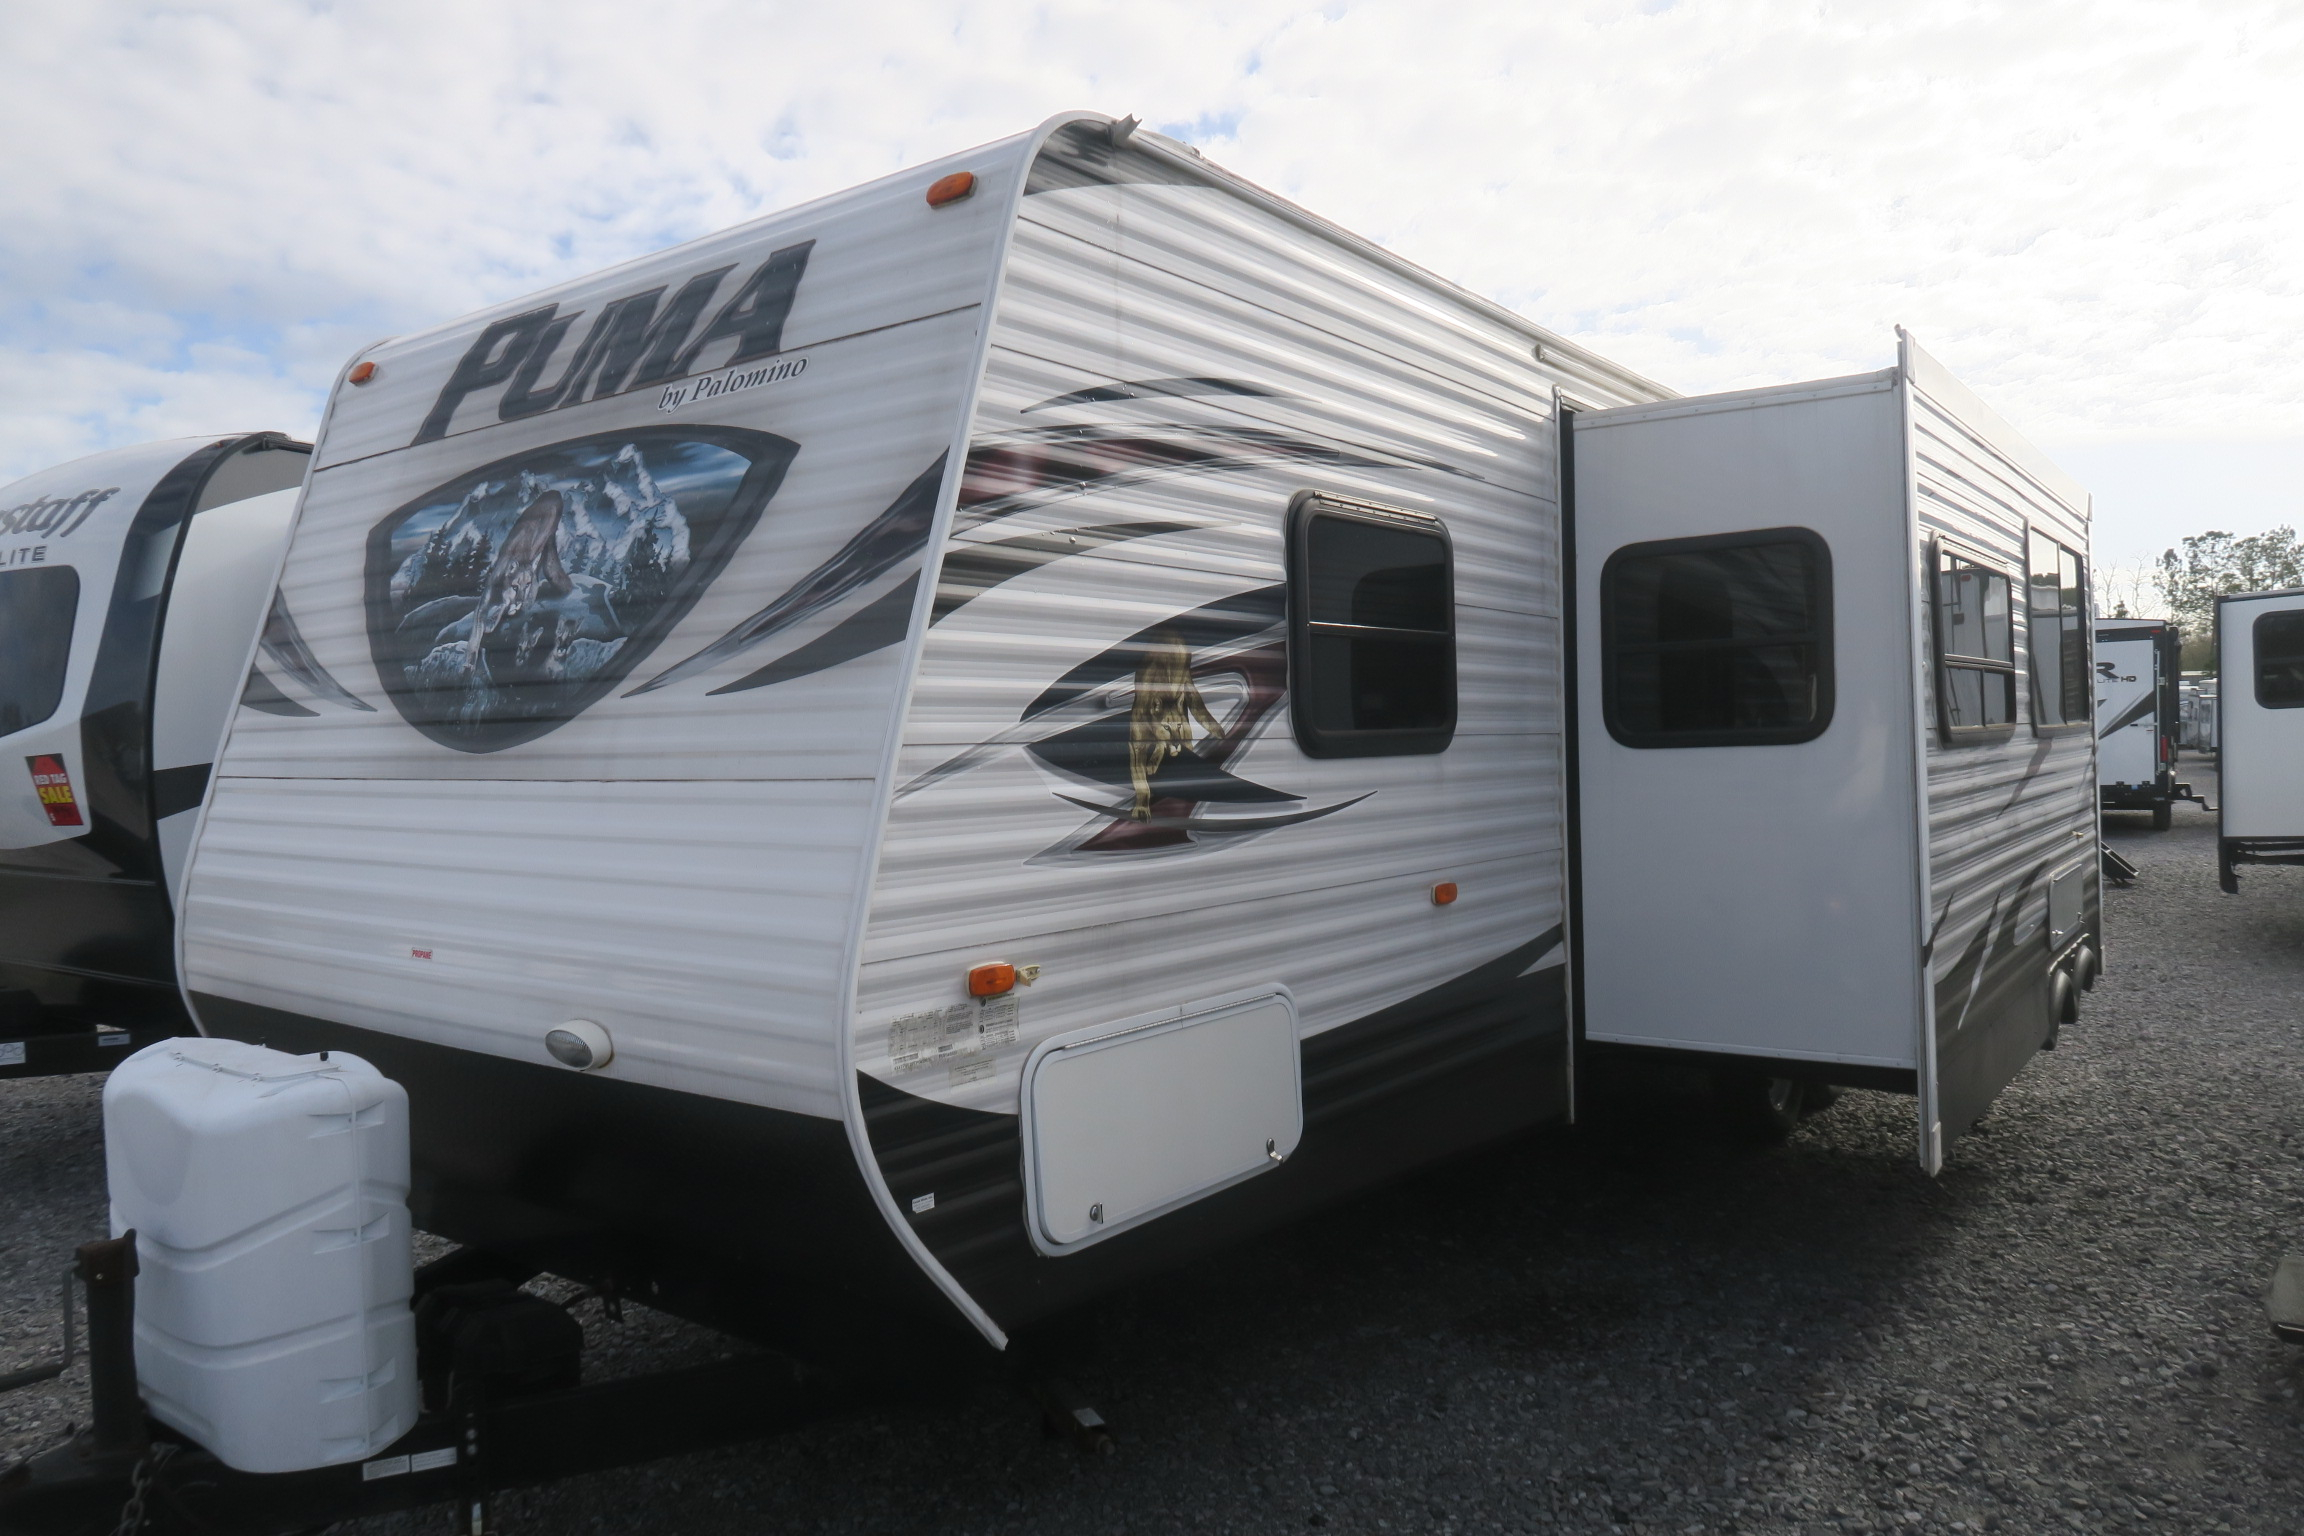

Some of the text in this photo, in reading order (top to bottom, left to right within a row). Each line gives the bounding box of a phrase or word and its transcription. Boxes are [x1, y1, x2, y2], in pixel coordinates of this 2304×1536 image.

[410, 239, 816, 446] PUMA
[658, 358, 808, 413] by Palomino
[0, 487, 121, 539] staff
[33, 773, 68, 785] RED TAG
[38, 785, 73, 804] SALE
[412, 949, 432, 960] PROPANE
